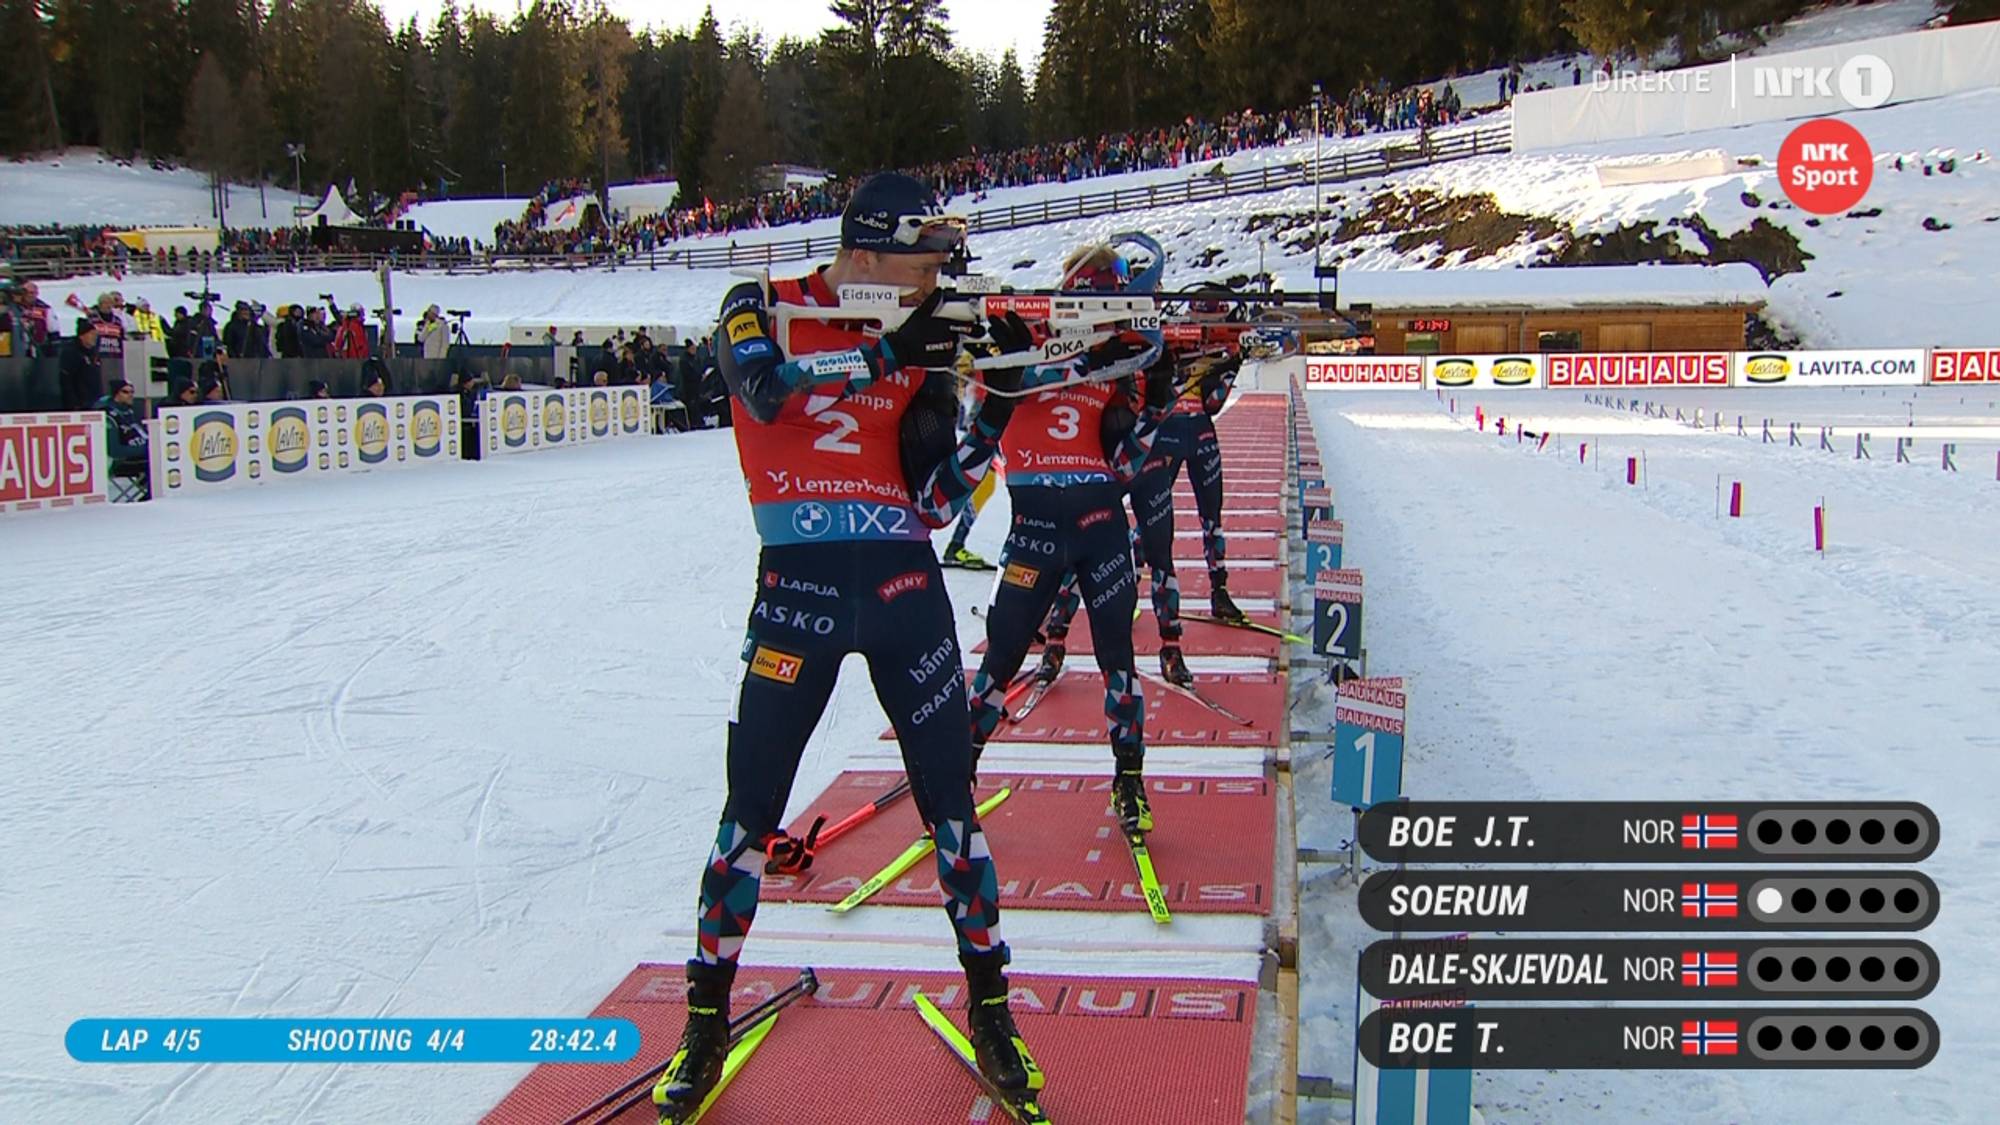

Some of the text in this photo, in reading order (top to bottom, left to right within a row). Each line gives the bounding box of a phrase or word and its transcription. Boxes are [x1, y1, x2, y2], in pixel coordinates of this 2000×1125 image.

[1044, 339, 1084, 360] JOKA
[1307, 366, 1420, 382] BAUHAUS
[1551, 357, 1726, 382] BAUHAUS
[1798, 360, 1916, 376] LAVITA.COM
[813, 410, 862, 455] 2
[1047, 405, 1081, 441] 3
[847, 504, 910, 534] iX2
[1008, 532, 1056, 555] ASKO
[1316, 545, 1332, 571] 3
[780, 576, 840, 599] LAPUA
[883, 574, 924, 598] MENY
[754, 601, 836, 635] ASKO
[1325, 603, 1349, 655] 2
[911, 674, 961, 725] CRAFT
[1339, 682, 1405, 708] BAUHAUS
[1336, 707, 1403, 734] BAUHAUS
[1353, 731, 1376, 805] 1
